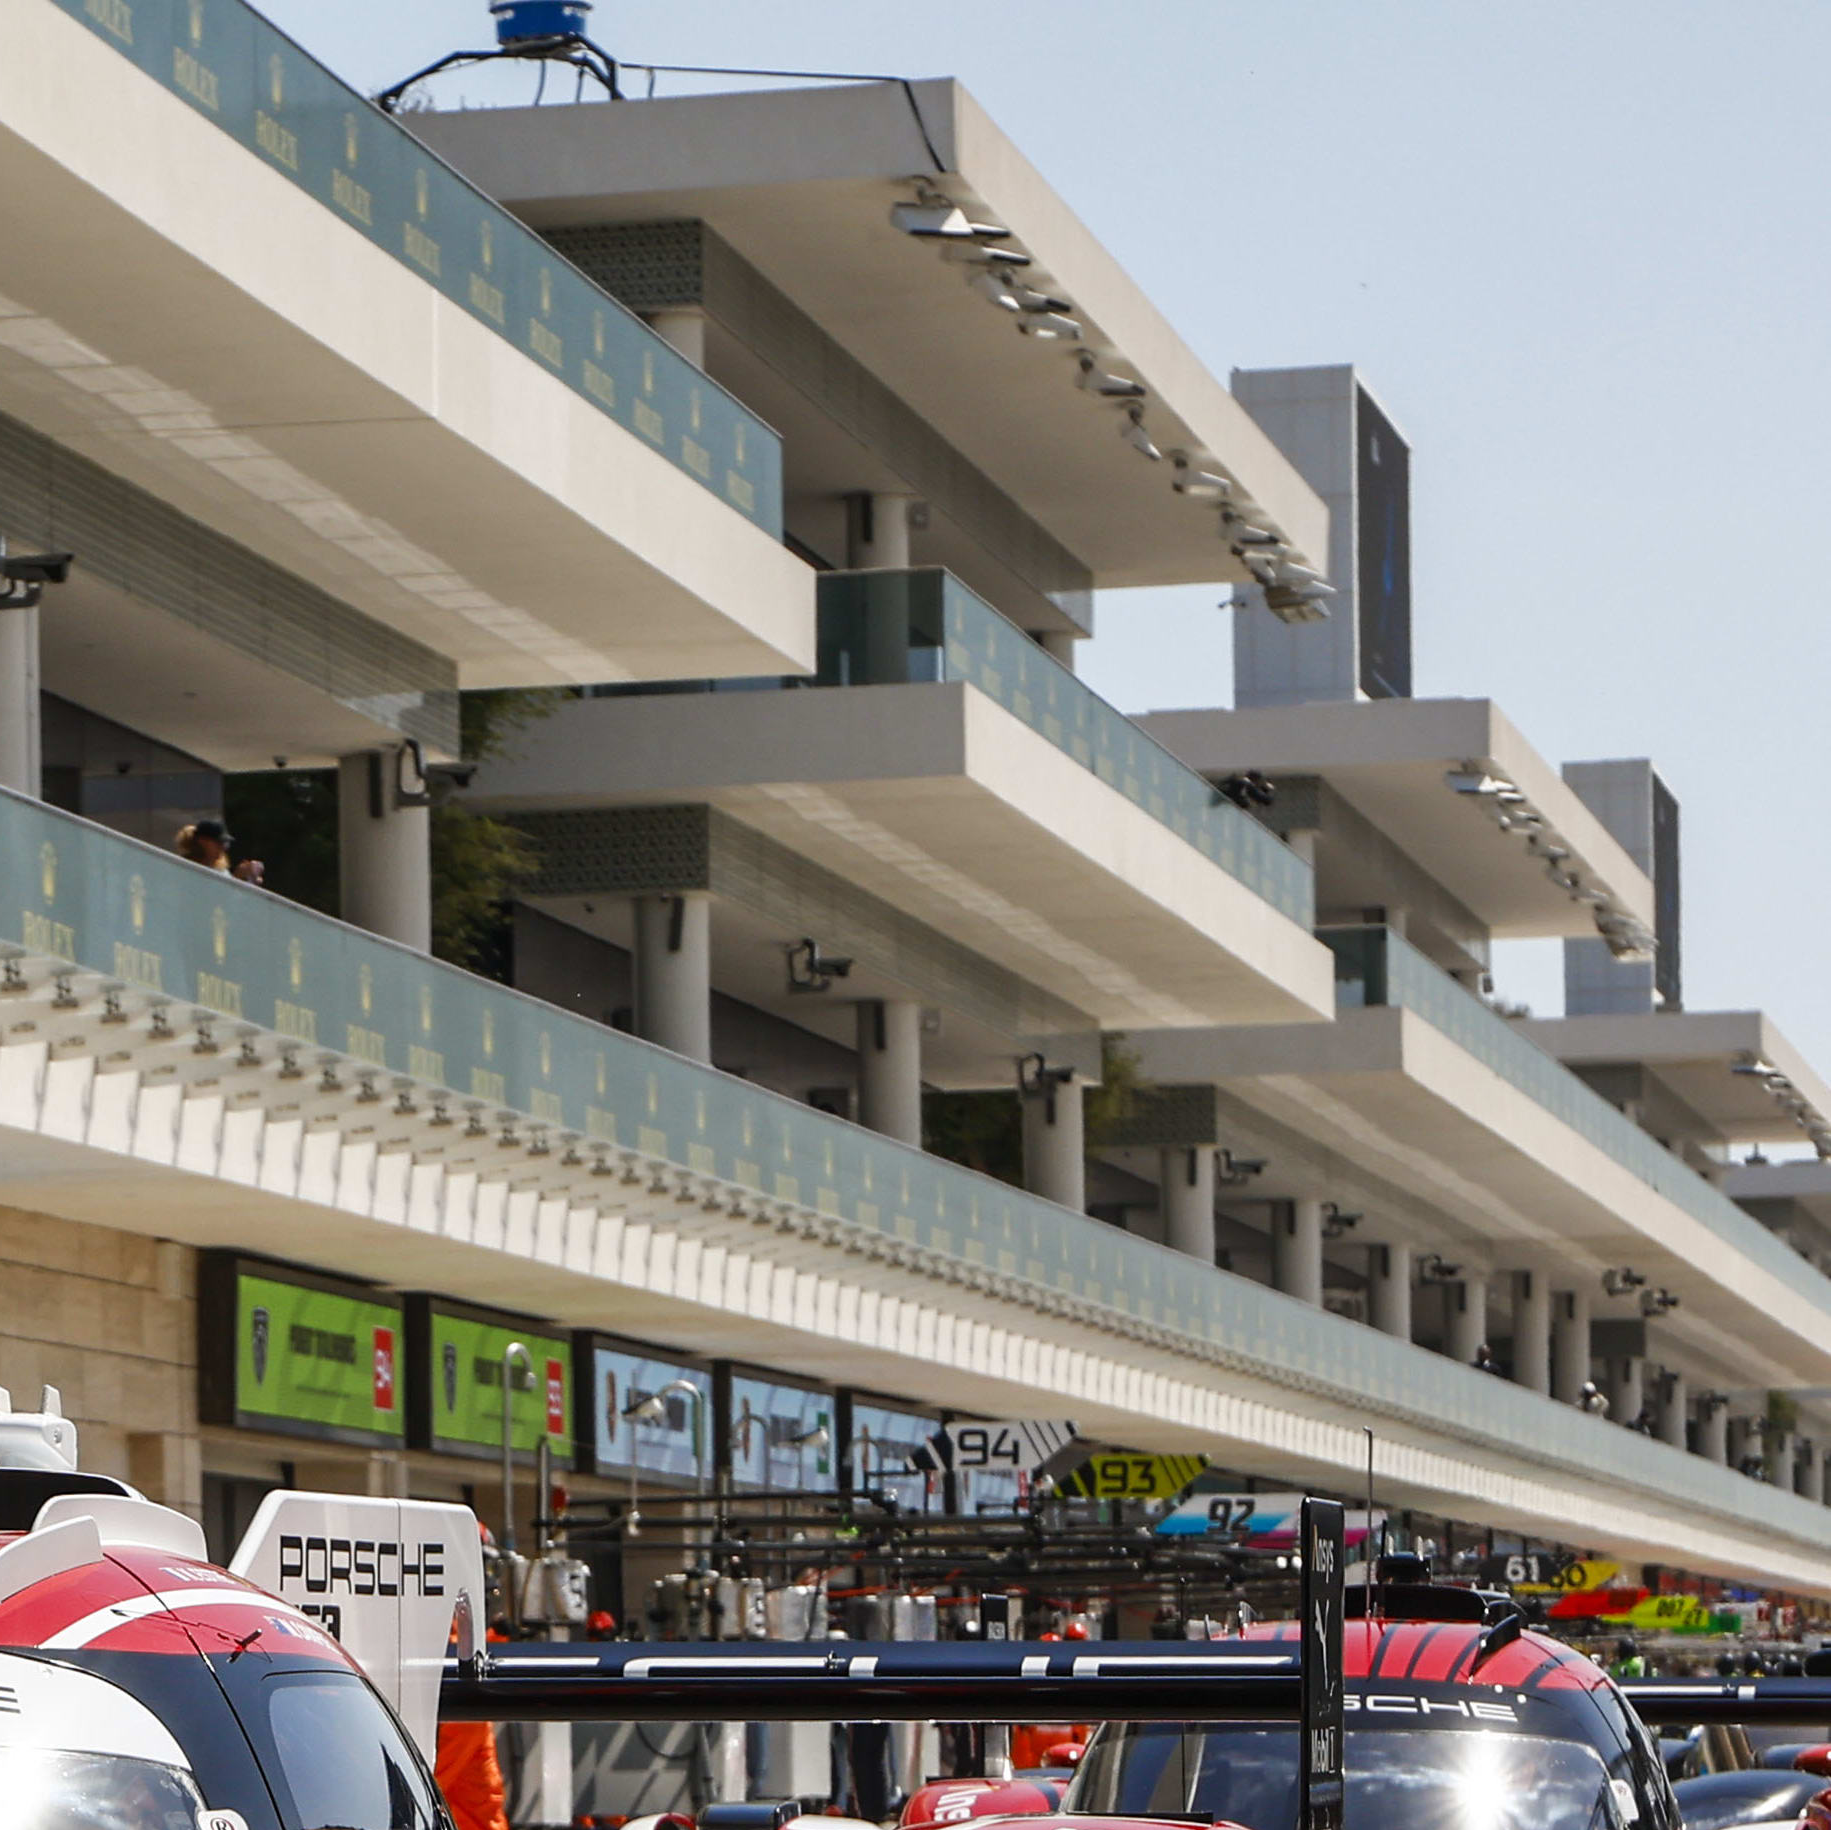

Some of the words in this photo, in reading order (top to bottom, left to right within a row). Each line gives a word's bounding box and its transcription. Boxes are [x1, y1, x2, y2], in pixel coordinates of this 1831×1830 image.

[958, 1427, 1019, 1465] 94
[1100, 1460, 1155, 1494] 93
[1207, 1500, 1255, 1531] 92
[280, 1535, 444, 1596] PORSCHE
[1507, 1556, 1539, 1582] 61
[1343, 1693, 1519, 1722] SCHE
